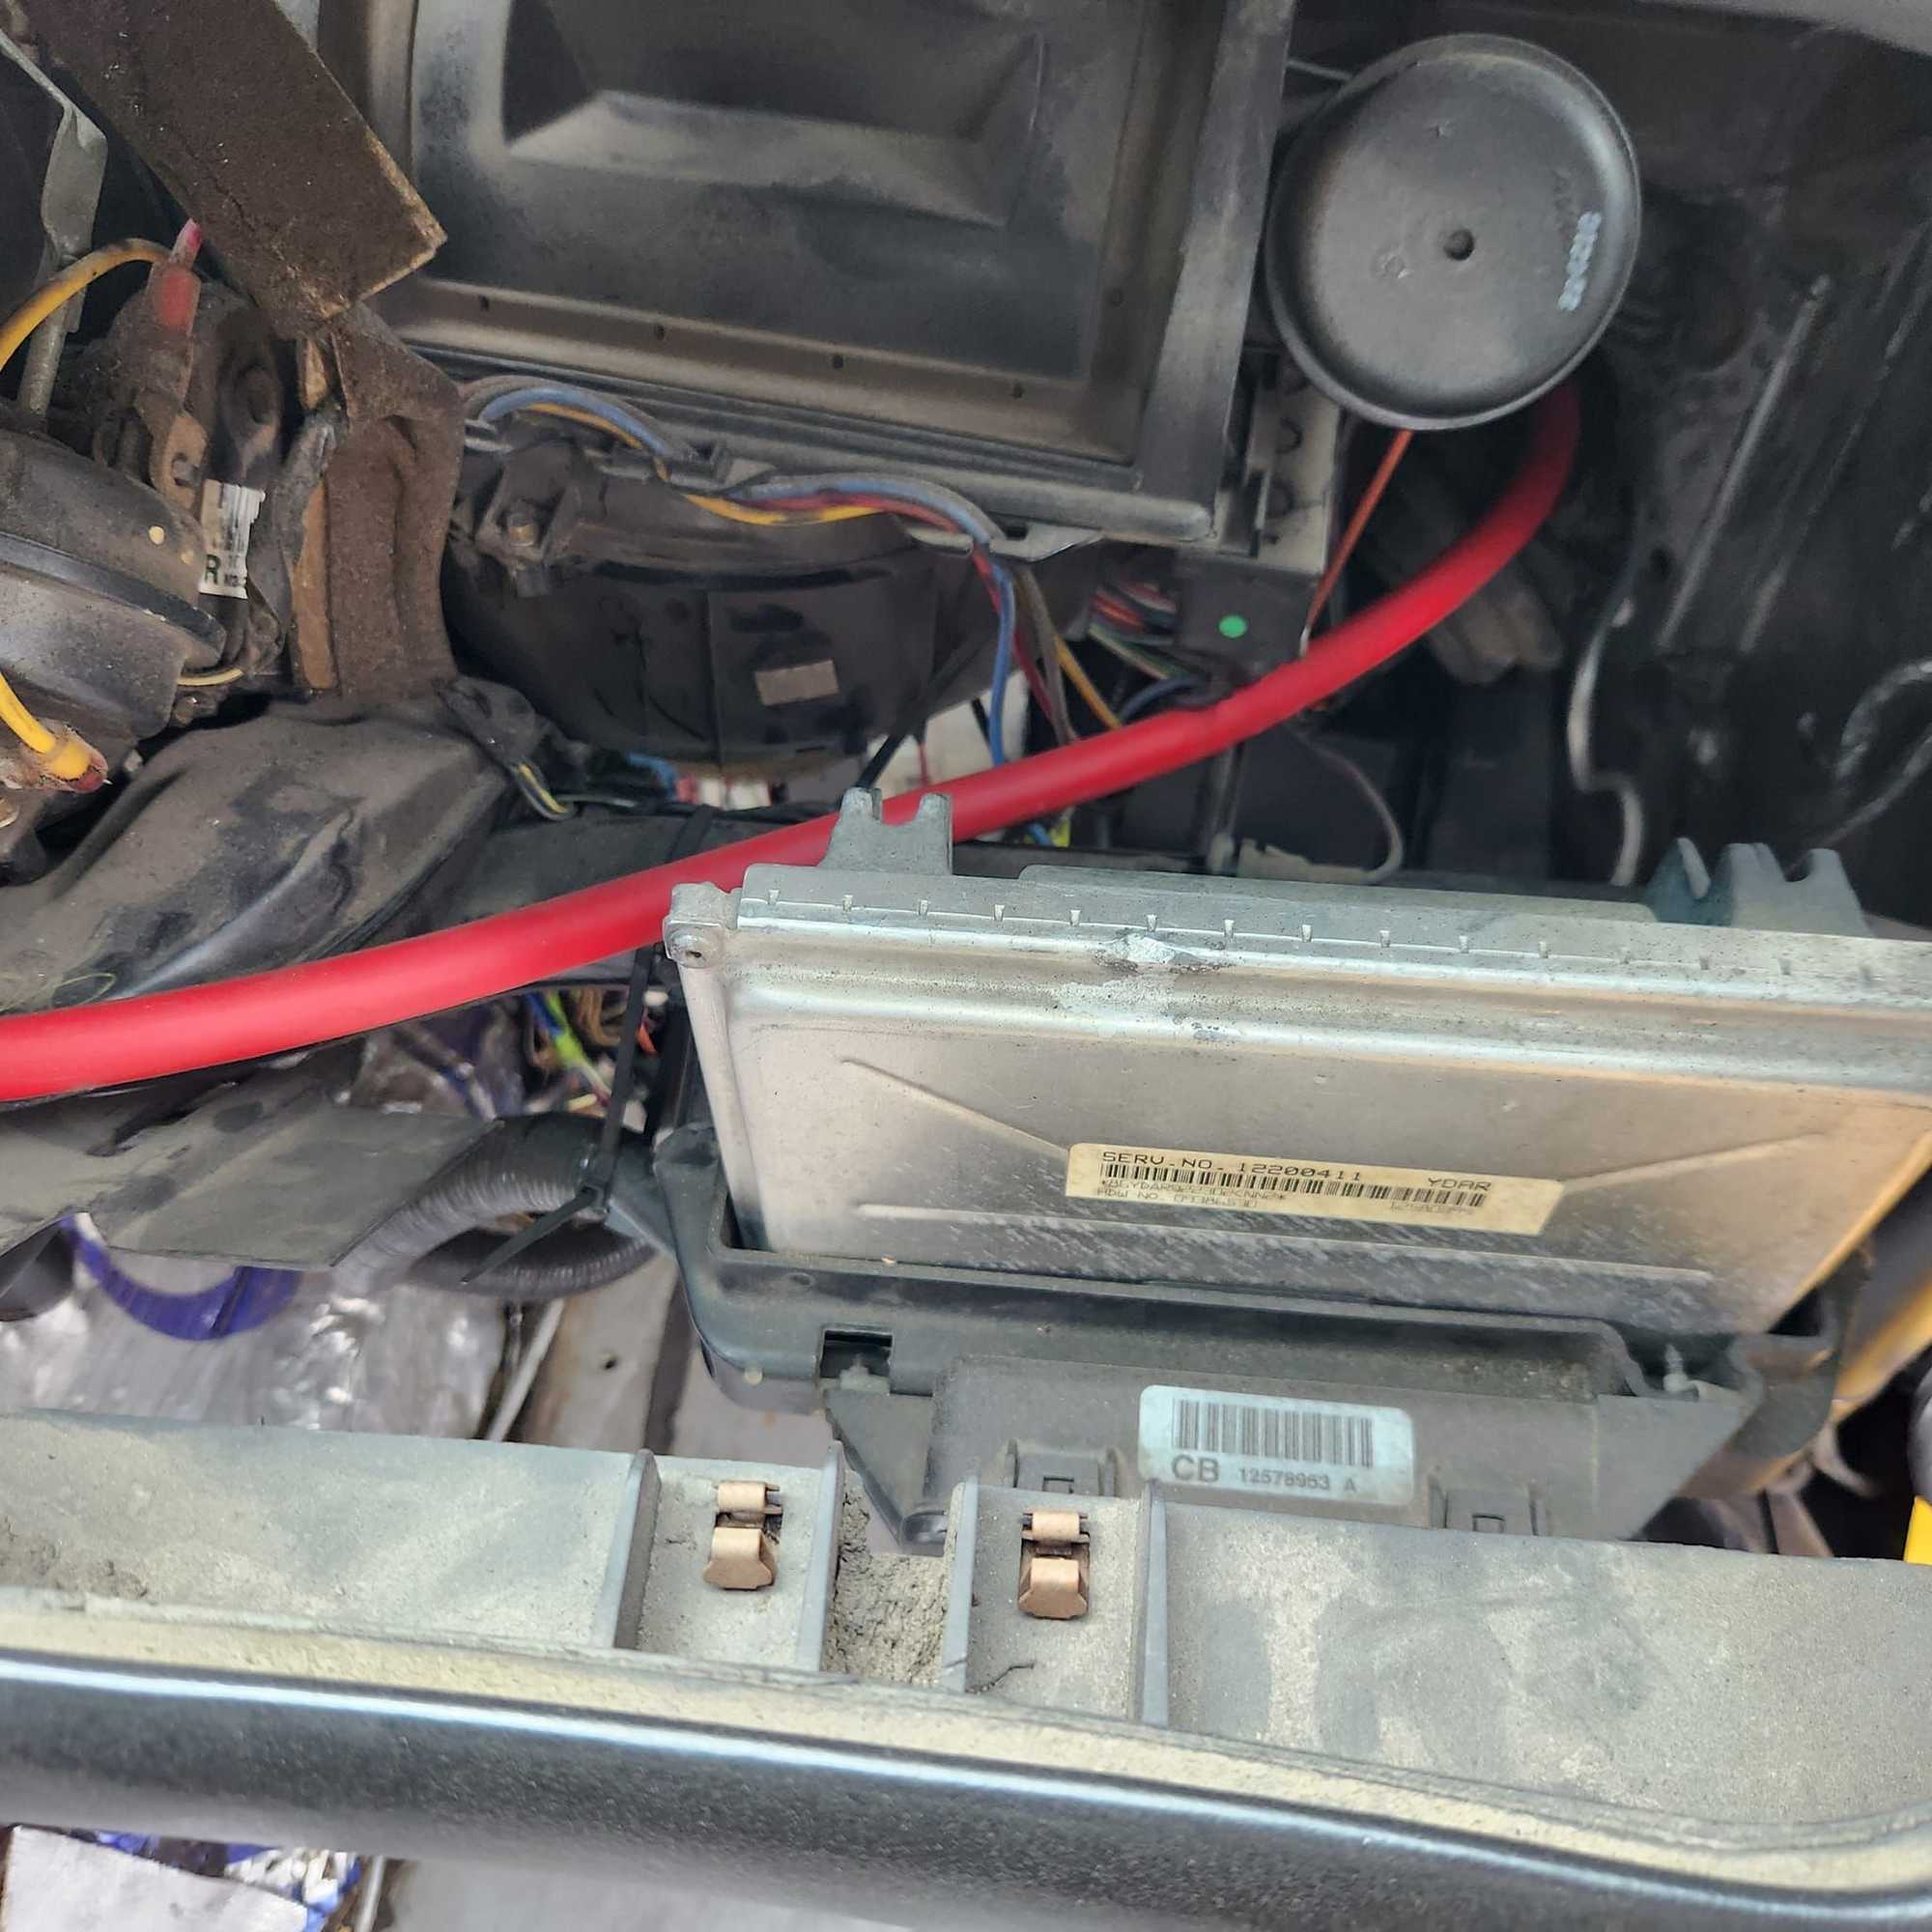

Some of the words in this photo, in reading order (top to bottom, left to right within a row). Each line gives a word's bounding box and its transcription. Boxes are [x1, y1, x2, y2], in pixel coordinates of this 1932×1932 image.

[1238, 1162, 1361, 1181] 12200411
[1428, 1177, 1492, 1192] YDAR
[1171, 1454, 1220, 1483] CB
[1344, 1478, 1357, 1492] A
